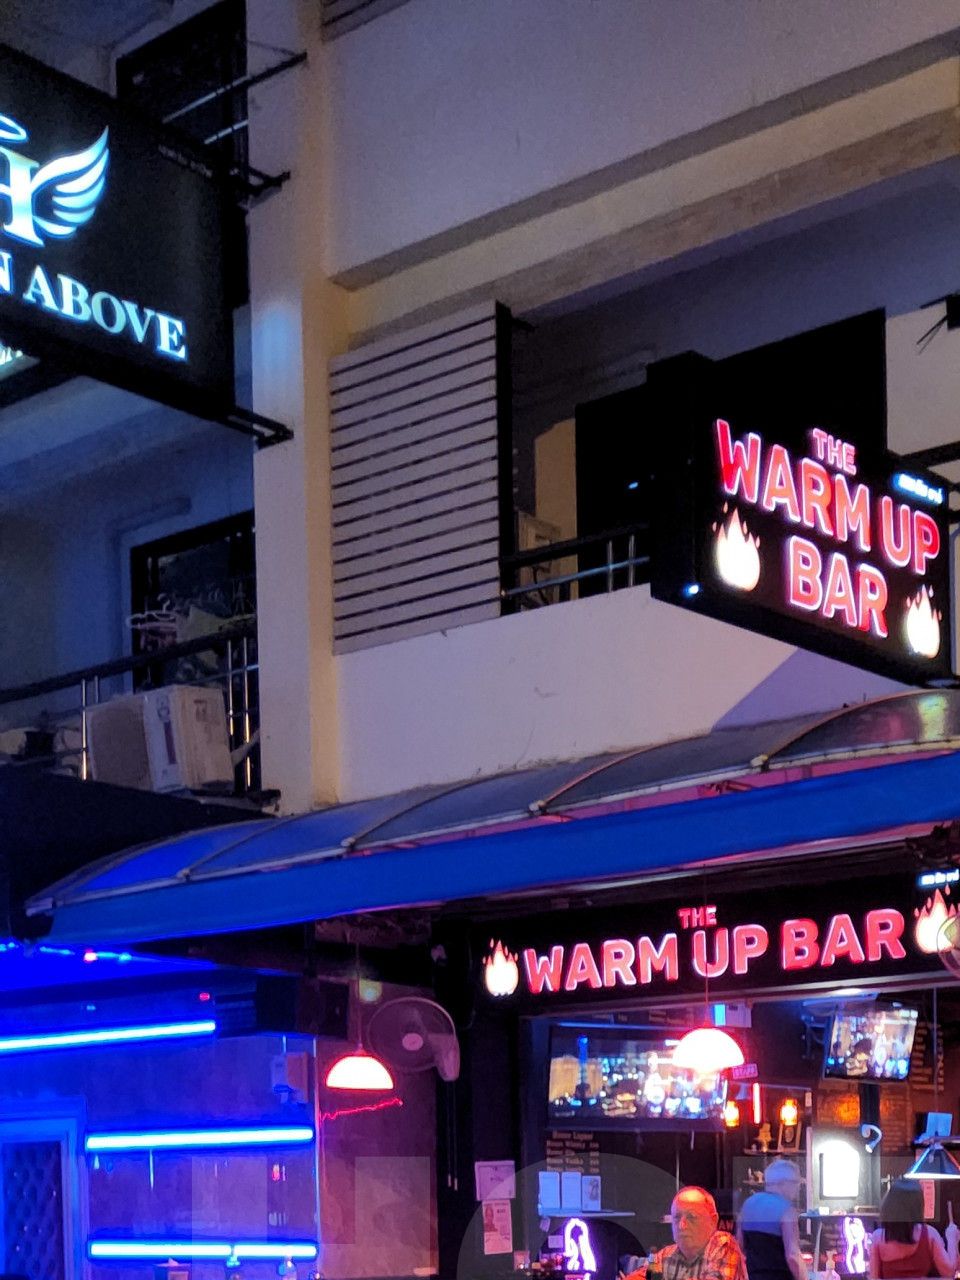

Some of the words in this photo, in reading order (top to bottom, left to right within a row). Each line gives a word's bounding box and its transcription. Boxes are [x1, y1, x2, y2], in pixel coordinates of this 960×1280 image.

[23, 264, 188, 361] ABOVE
[715, 418, 872, 552] WARM
[881, 495, 941, 575] UP
[813, 428, 856, 476] THE
[789, 534, 888, 638] BAR
[523, 932, 679, 994] WARM
[692, 924, 767, 978] UP
[782, 908, 906, 970] BAR
[678, 905, 717, 930] THE
